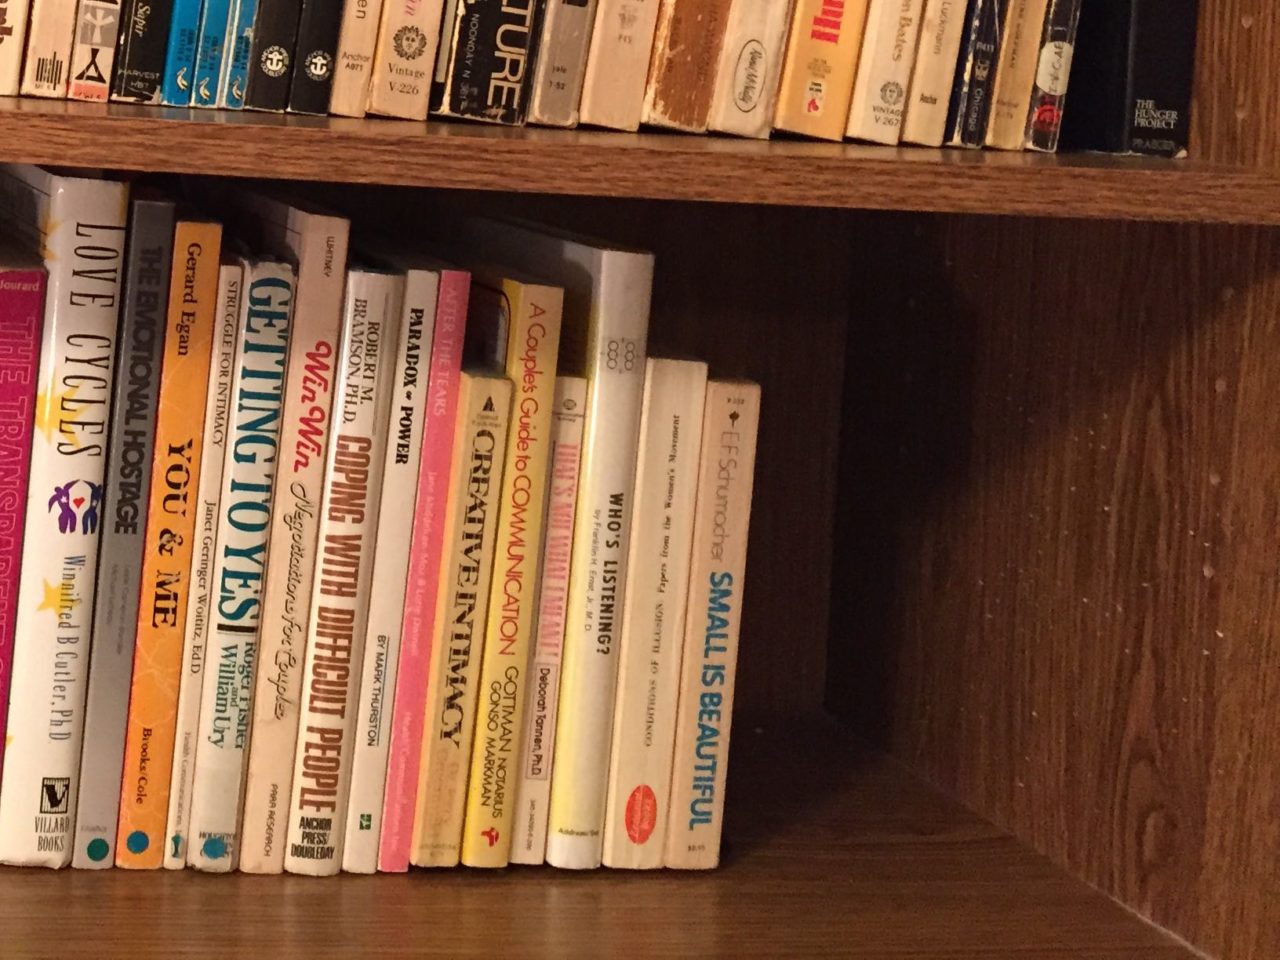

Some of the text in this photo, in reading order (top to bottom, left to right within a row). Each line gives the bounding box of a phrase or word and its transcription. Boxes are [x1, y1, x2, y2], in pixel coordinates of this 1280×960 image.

[387, 62, 425, 80] Vintage
[1134, 117, 1176, 130] PROJECT
[57, 222, 126, 458] LOVE CYCLES
[176, 242, 202, 356] Gerard Egan
[359, 320, 381, 376] ROBERT
[395, 307, 425, 465] PARADOX POWER
[217, 277, 293, 622] GETTING TO YES
[499, 474, 532, 656] COMMUNICATION
[596, 492, 624, 656] WHO'S LISTENING?
[297, 434, 372, 813] COPING WITH DIFFICULT PEOPLE
[366, 687, 383, 747] THURSTON
[499, 665, 520, 751] GOTTMAN
[687, 571, 733, 831] SMALL BEAUTIFUL
[480, 736, 495, 806] MARKMAN
[34, 816, 71, 833] VILLARD
[36, 836, 65, 852] BOOKS
[291, 843, 334, 860] DOUBLEDAY
